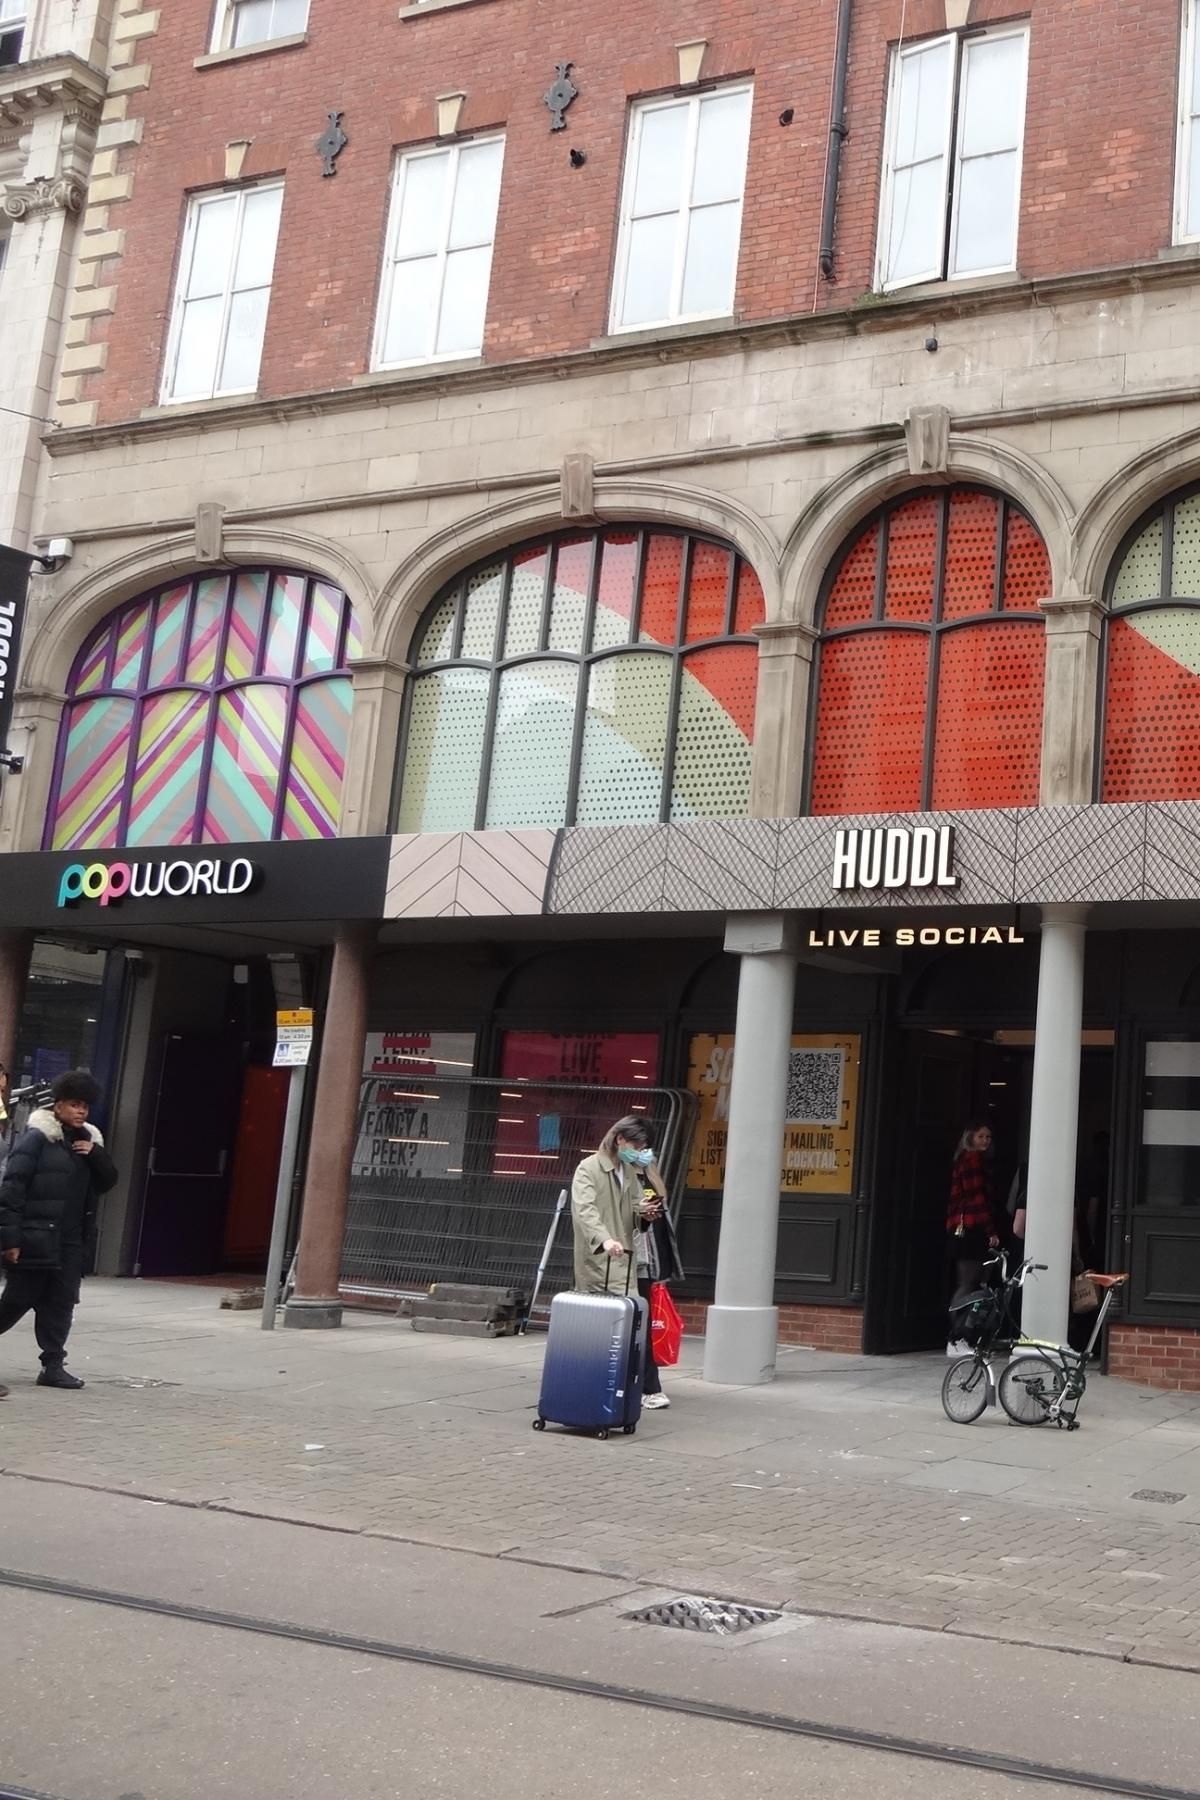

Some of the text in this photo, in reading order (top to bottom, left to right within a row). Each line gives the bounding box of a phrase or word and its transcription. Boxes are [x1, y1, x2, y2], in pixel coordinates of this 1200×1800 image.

[832, 825, 956, 889] HUDDL
[809, 926, 1024, 946] LIVE SOCIAL
[561, 1041, 602, 1073] LIVE
[790, 1132, 833, 1149] MAILING
[701, 1149, 721, 1165] LIST
[787, 1151, 838, 1169] COCKTAIL
